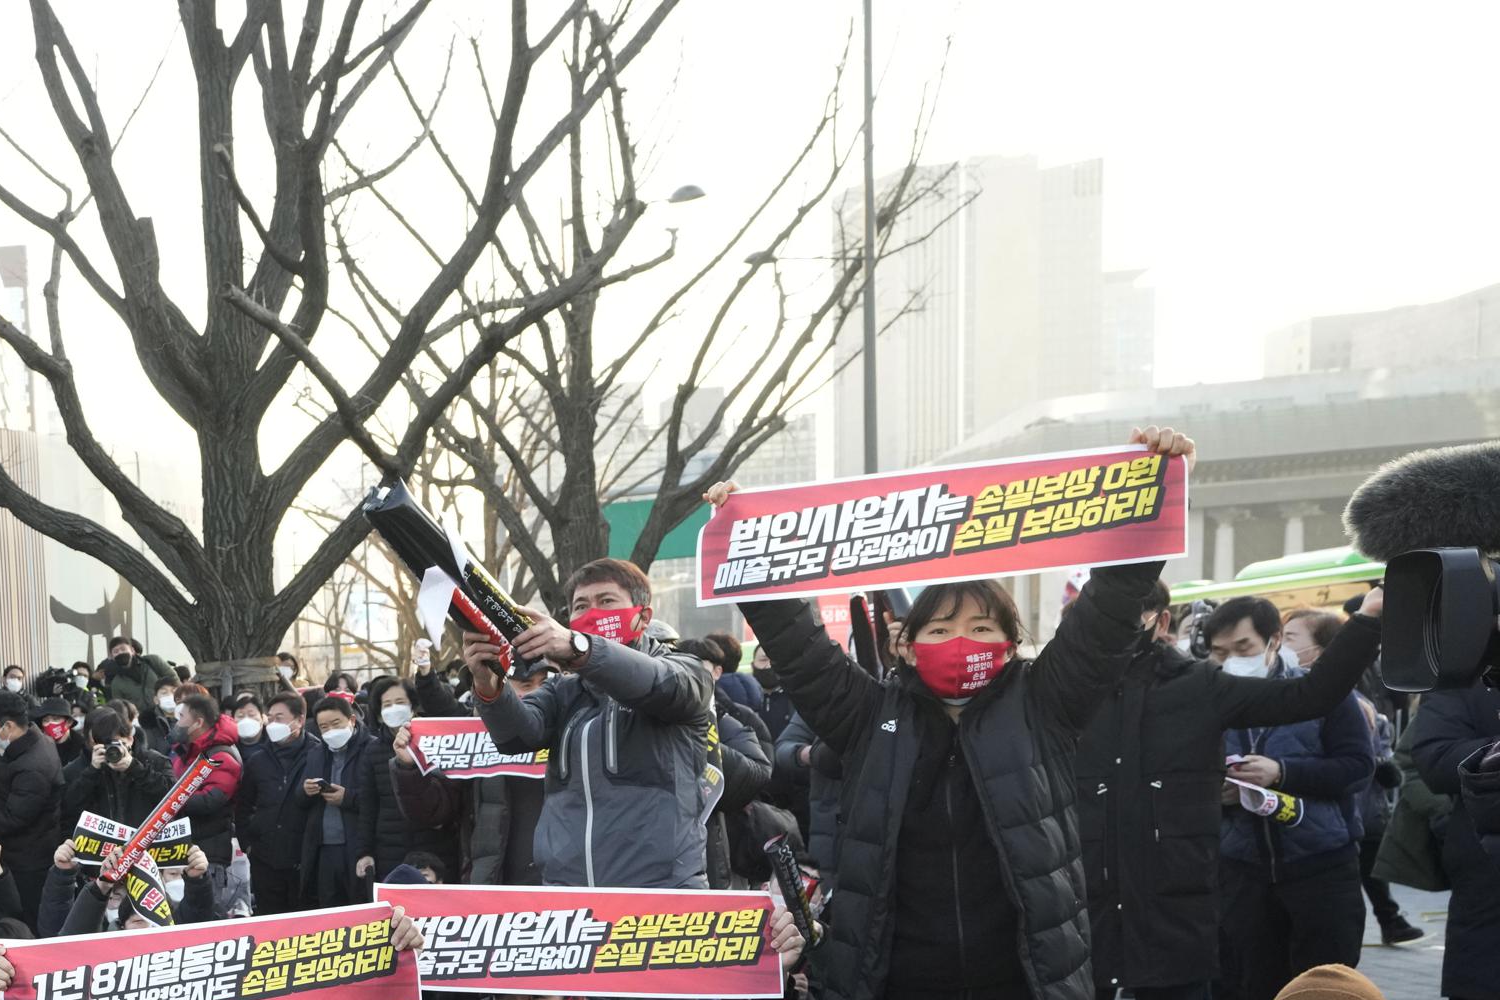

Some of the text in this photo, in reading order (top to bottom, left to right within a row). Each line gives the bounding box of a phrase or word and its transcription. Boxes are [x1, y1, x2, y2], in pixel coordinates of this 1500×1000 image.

[713, 487, 1159, 589] 매출규모 상관없이 손실 보상하라!
[728, 455, 1160, 557] 법인사업자는 손실보상 0원
[488, 944, 593, 973] 상관없이
[594, 942, 648, 968] 손실
[649, 935, 760, 964] 보상하라!
[611, 911, 716, 941] 손실보상
[716, 908, 764, 935] 0원
[88, 936, 250, 999] 8개월동안
[251, 930, 347, 967] 손실보상
[349, 918, 392, 947] 0원
[240, 967, 290, 997] 손실
[292, 946, 393, 987] 보상하라!
